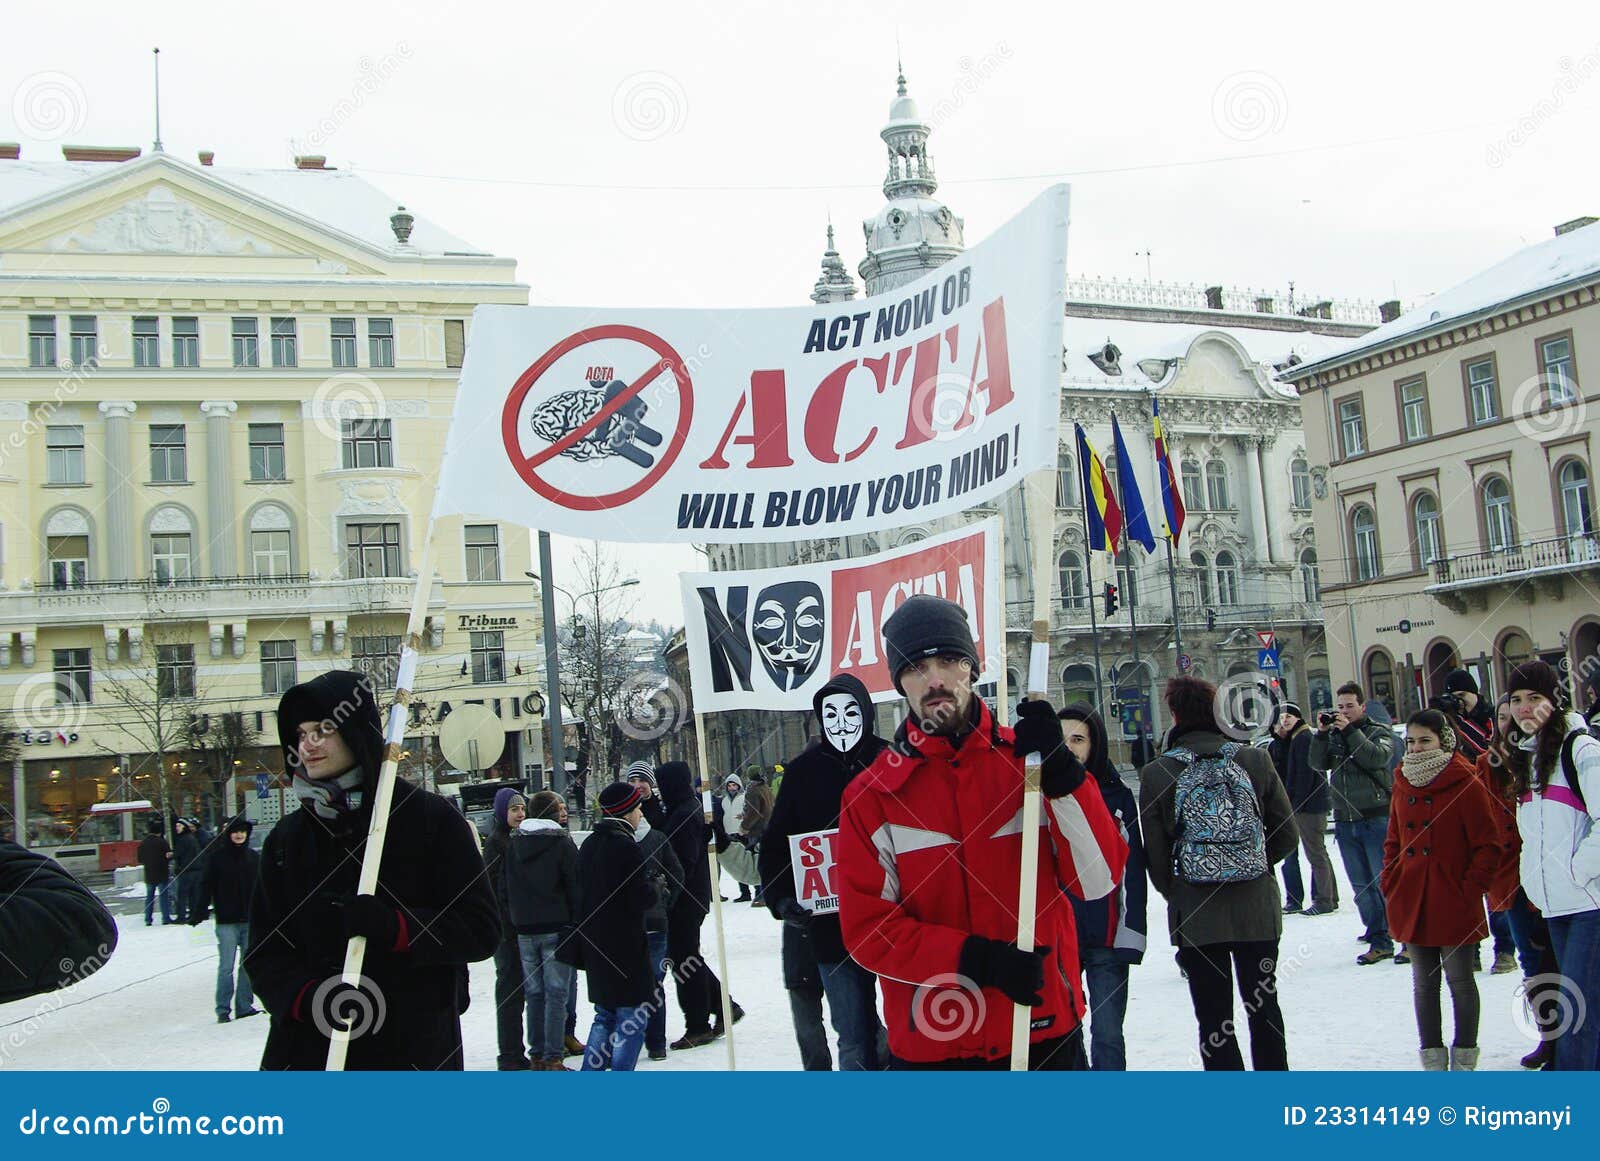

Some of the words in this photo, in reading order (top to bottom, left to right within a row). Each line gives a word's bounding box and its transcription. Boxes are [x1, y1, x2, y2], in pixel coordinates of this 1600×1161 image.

[803, 311, 871, 354] ACT
[874, 284, 938, 343] NOW
[942, 266, 971, 315] OR
[585, 366, 614, 381] ACTA
[700, 296, 1016, 470] ACTA
[677, 493, 755, 529] WILL
[762, 483, 861, 528] BLOW
[866, 463, 943, 518] YOUR
[458, 614, 517, 627] Tribuna
[815, 897, 840, 910] PROTE
